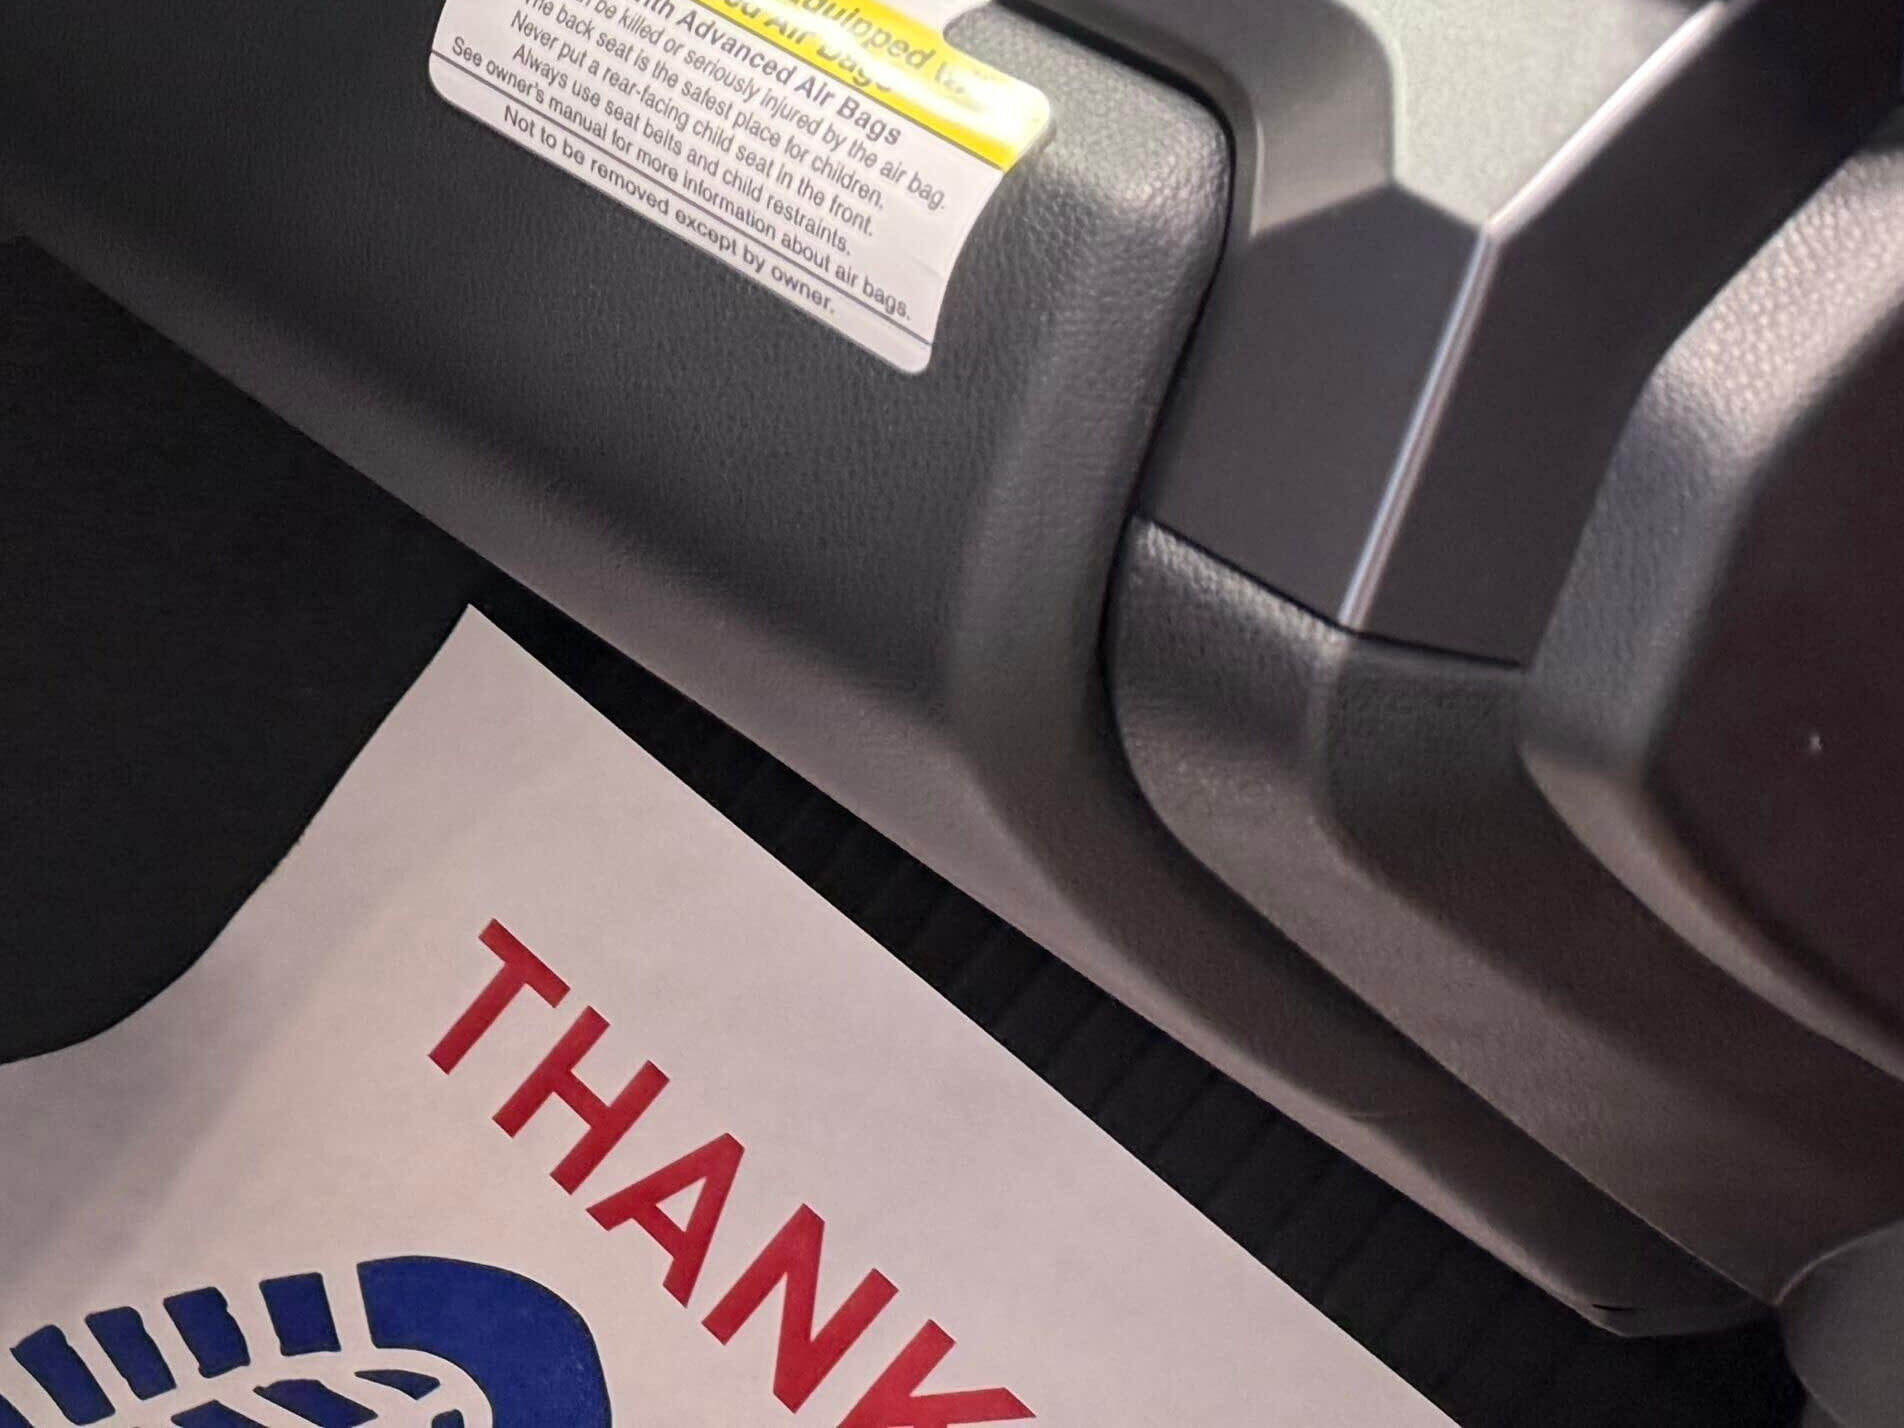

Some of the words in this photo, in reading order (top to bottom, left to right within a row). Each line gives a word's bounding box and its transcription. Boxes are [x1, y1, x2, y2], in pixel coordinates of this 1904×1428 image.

[451, 35, 482, 67] See
[485, 59, 544, 104] owner's
[547, 95, 608, 141] manual
[610, 127, 633, 155] for
[635, 147, 679, 182] more
[681, 169, 776, 241] information
[780, 232, 830, 273] about
[834, 264, 858, 288] air
[861, 275, 910, 320] bags.
[509, 9, 559, 50] Never
[556, 41, 587, 68] put
[587, 59, 600, 76] a
[601, 66, 690, 132] rear-facing
[691, 119, 735, 153] child
[734, 144, 774, 178] seat
[775, 162, 793, 190] in
[796, 176, 825, 207] the
[828, 193, 872, 237] front.
[511, 43, 568, 89] Always
[571, 79, 601, 108] use
[603, 99, 640, 131] seat
[642, 116, 682, 156] belts
[685, 147, 720, 177] and
[721, 168, 764, 203] child
[765, 194, 850, 256] restraints.
[555, 3, 595, 41] back
[595, 31, 634, 63] seat
[632, 48, 650, 72] is
[651, 59, 679, 88] the
[680, 79, 733, 120] safest
[730, 110, 781, 148] place
[783, 134, 810, 163] for
[810, 154, 883, 209] children.
[617, 7, 665, 46] killed
[662, 37, 685, 56] or
[682, 48, 761, 103] seriously
[759, 87, 824, 136] injured
[821, 122, 847, 153] by
[846, 138, 878, 168] the
[879, 160, 907, 184] air
[906, 170, 945, 211] bag.
[674, 9, 797, 85] Advanced
[792, 75, 835, 107] Air
[835, 95, 901, 145] Bags
[503, 104, 535, 138] Not
[539, 126, 557, 149] to
[561, 139, 585, 165] be
[589, 158, 669, 215] removed
[674, 208, 737, 255] except
[742, 243, 765, 274] by
[770, 265, 834, 313] owner.
